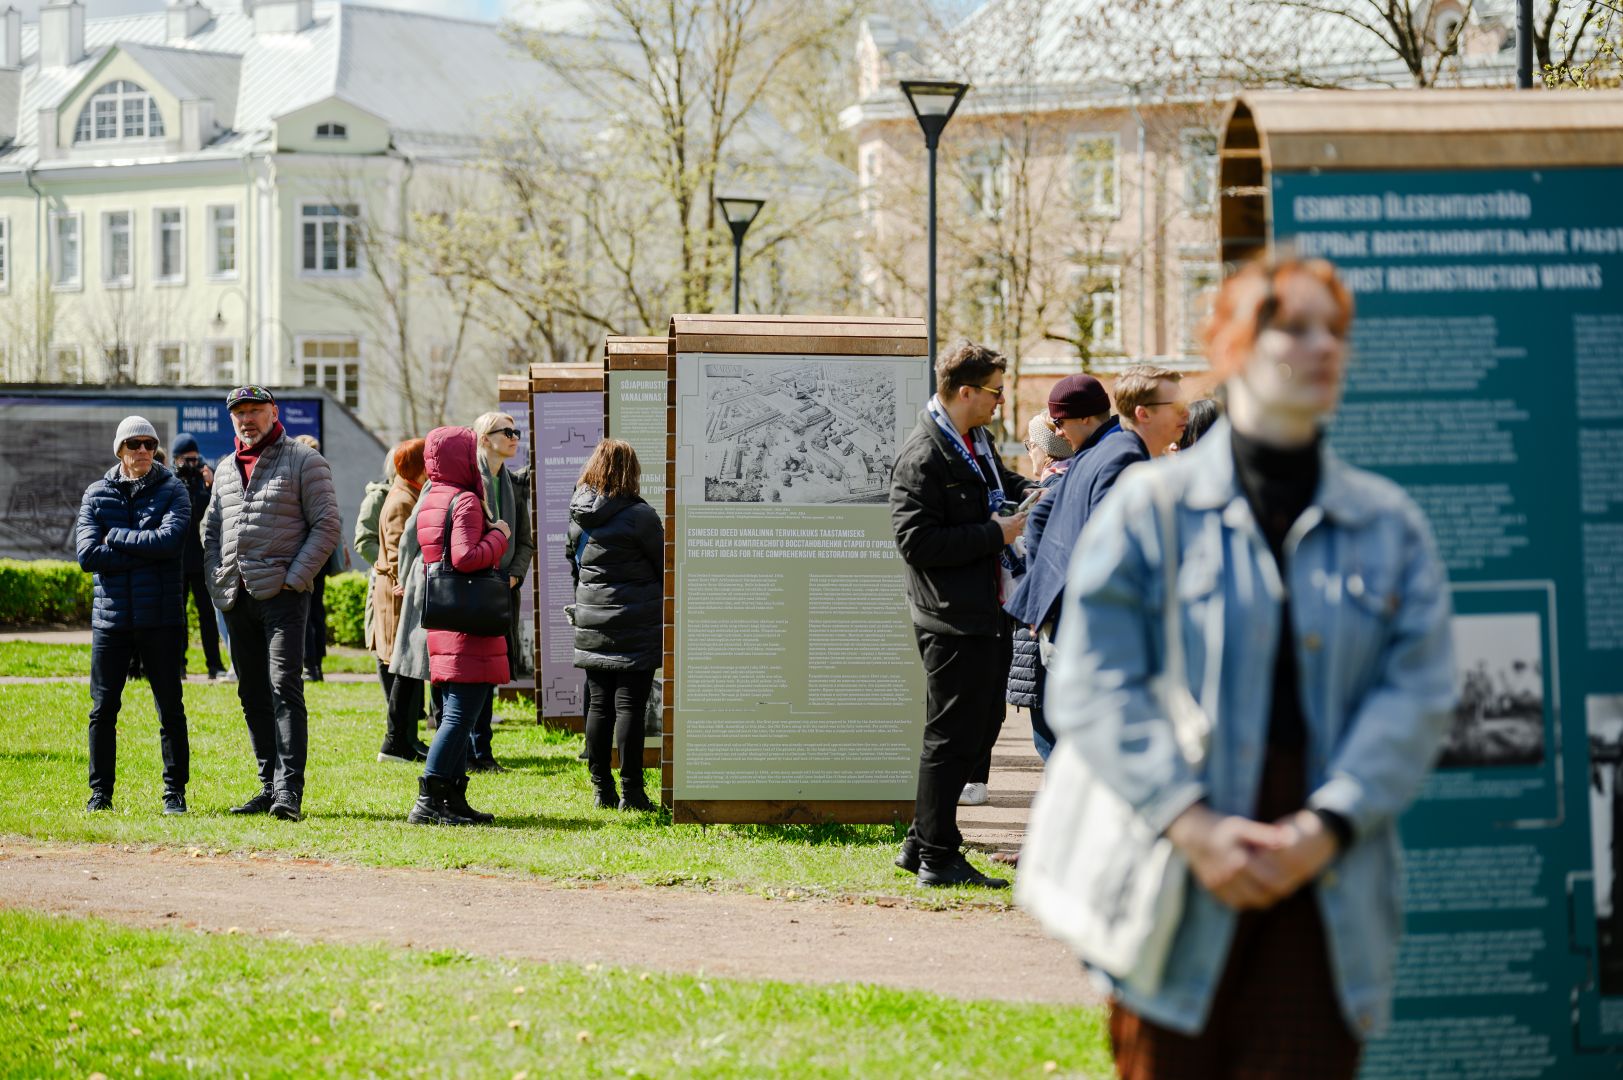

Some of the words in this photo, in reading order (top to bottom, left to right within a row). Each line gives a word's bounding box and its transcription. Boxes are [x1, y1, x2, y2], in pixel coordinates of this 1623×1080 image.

[1293, 194, 1382, 222] ESIMESED
[1371, 228, 1567, 256] ВОССТАНОВИТЕЛЬНЫЕ
[1571, 227, 1623, 254] РАБОТ
[1388, 264, 1538, 292] RECONSTRUCTION
[1541, 263, 1602, 290] WORKS
[620, 380, 666, 390] SÕJAPURUSTU
[620, 392, 662, 402] VANALINNAS
[544, 457, 565, 465] NARVA
[687, 528, 719, 537] ESIMESED
[719, 528, 738, 537] IDEED
[739, 529, 774, 537] VANALINNA
[775, 529, 819, 537] TERVIKLIKUKS
[820, 529, 865, 537] TAASTAMISEKS
[687, 539, 714, 547] ПЕРВЫЕ
[714, 539, 733, 547] ИДЕИ
[733, 539, 784, 547] КОМПЛЕКСНОГО
[785, 540, 842, 548] ВОССТАНОВЛЕНИЯ
[843, 540, 871, 548] СТАРОГО
[687, 549, 700, 558] THE
[701, 549, 718, 558] FIRST
[719, 549, 738, 558] IDEAS
[739, 549, 752, 558] FOR
[752, 549, 765, 558] THE
[765, 550, 817, 558] COMPREHENSIVE
[817, 550, 859, 558] RESTORATION
[859, 550, 867, 558] OF
[869, 550, 881, 558] THE
[882, 550, 894, 559] OLD
[895, 550, 904, 559] TO
